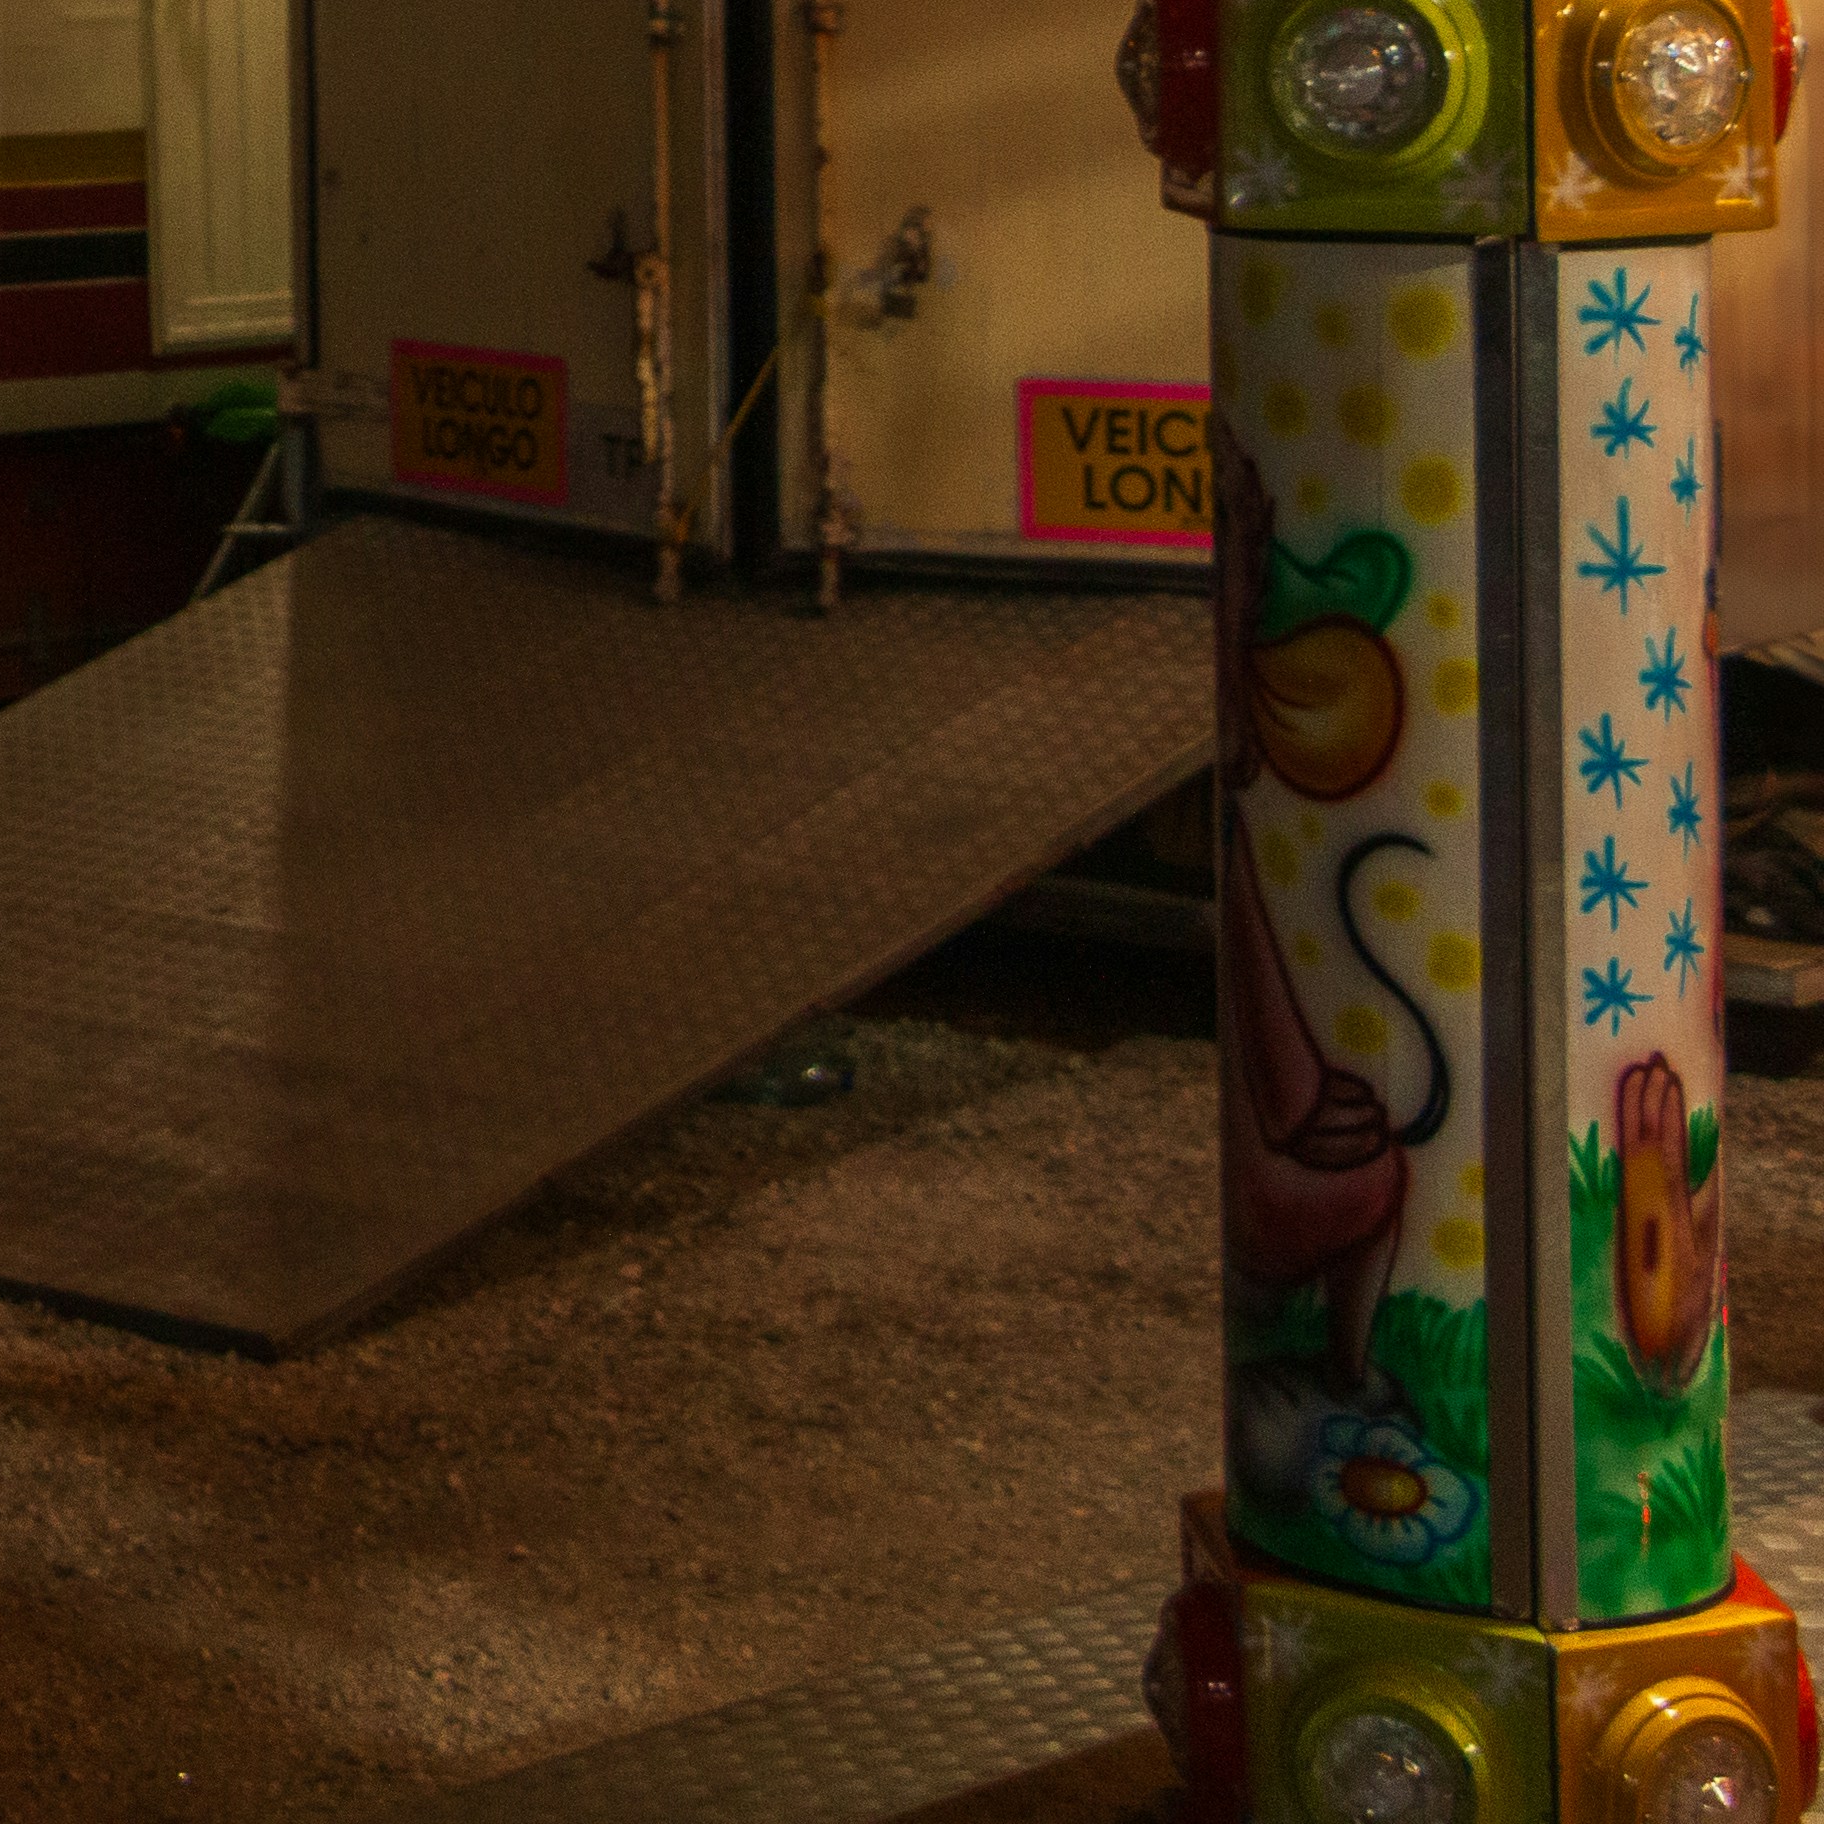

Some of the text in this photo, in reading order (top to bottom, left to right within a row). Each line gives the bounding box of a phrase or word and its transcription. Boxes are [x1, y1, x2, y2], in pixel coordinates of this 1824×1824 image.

[411, 366, 543, 420] VEICULO
[422, 416, 538, 471] LONGO
[1084, 464, 1203, 514] LON
